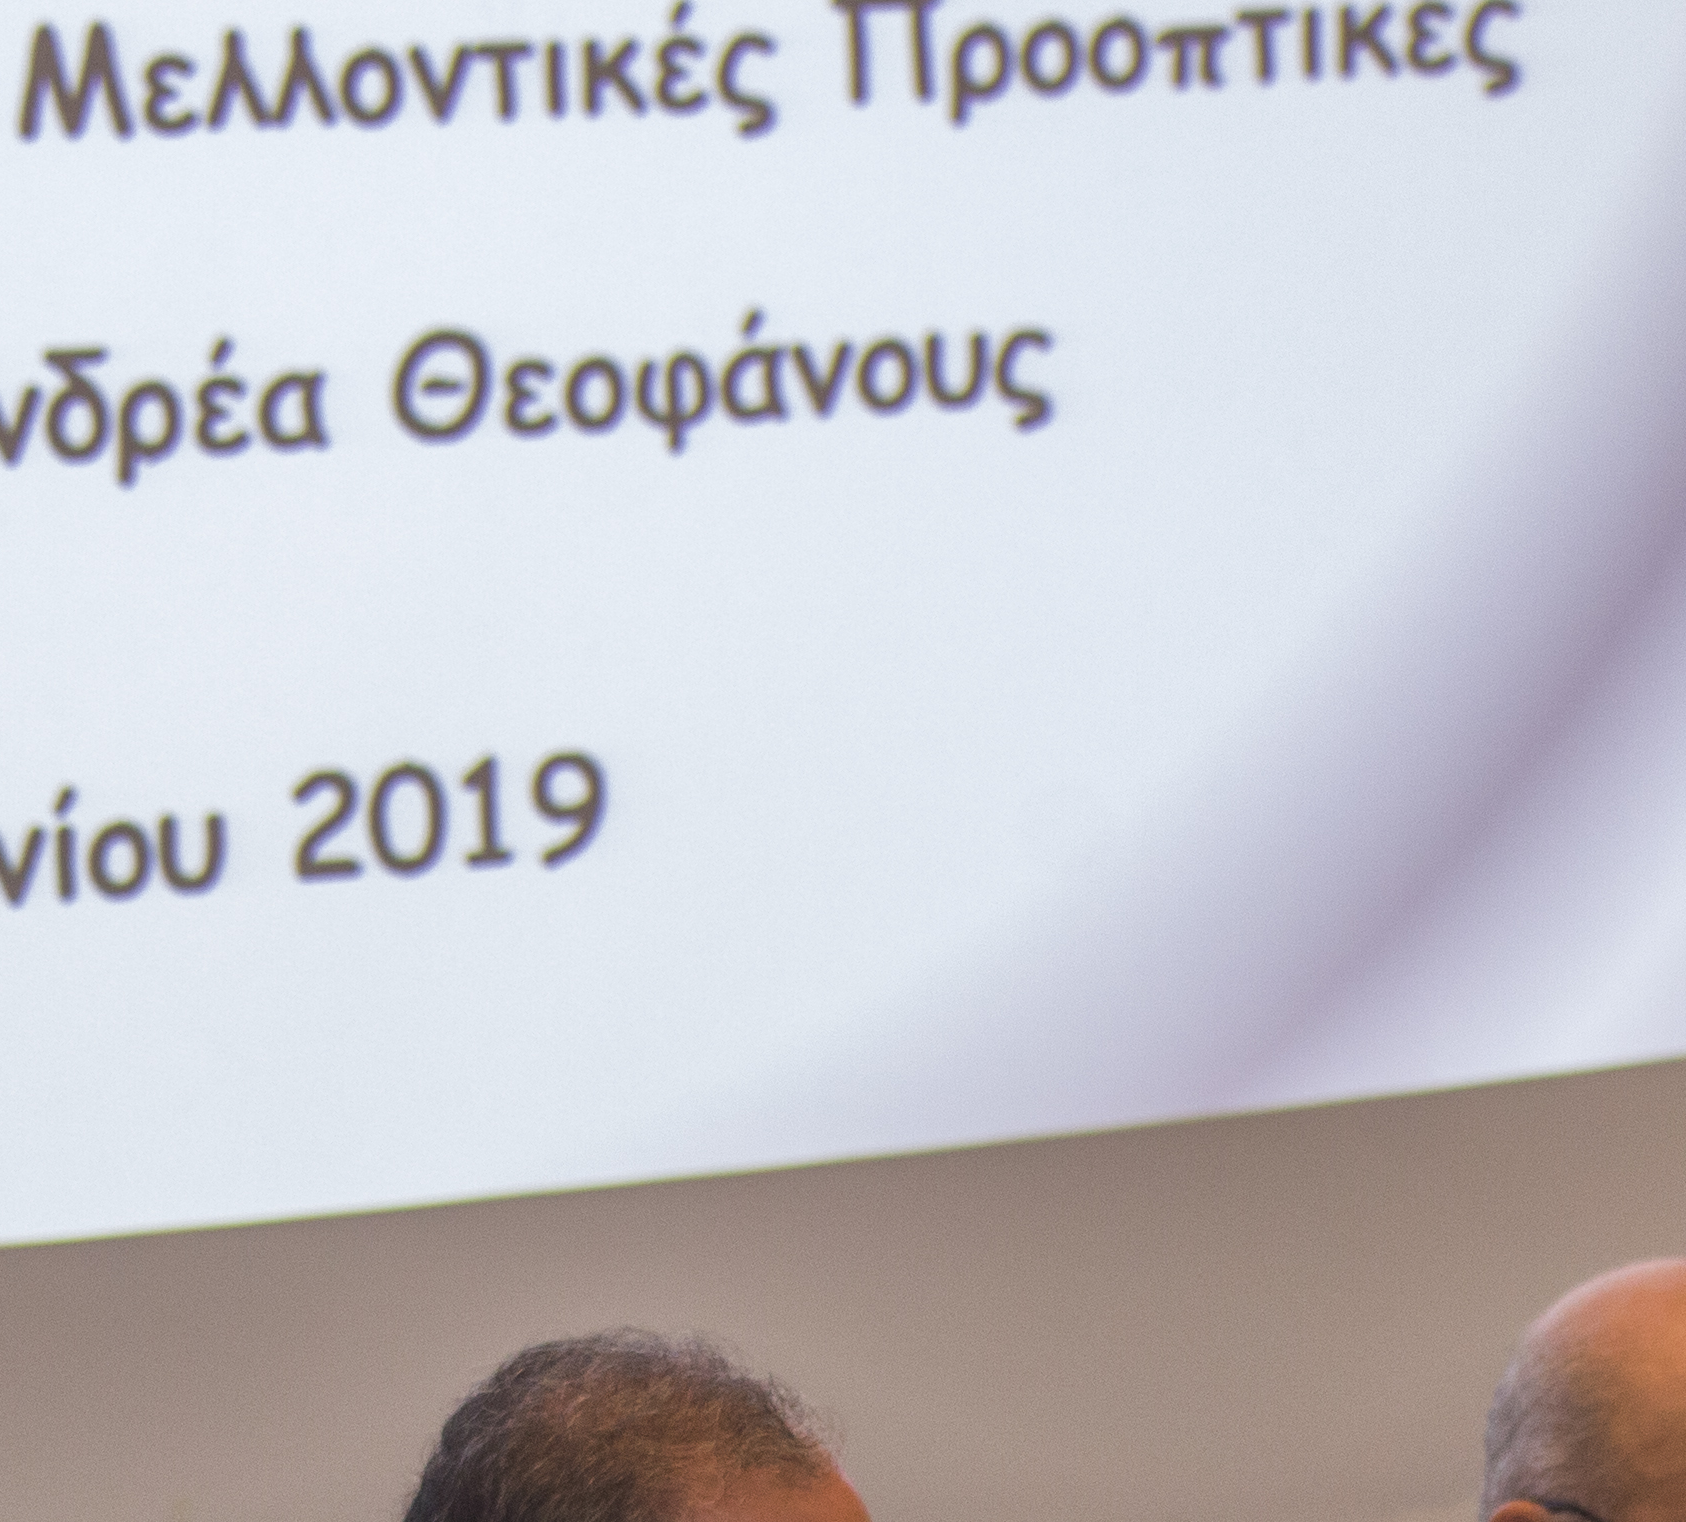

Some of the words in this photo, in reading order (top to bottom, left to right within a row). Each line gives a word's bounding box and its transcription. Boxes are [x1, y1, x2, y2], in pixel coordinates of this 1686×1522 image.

[16, 2, 779, 144] Μελλοντικές
[389, 308, 1056, 456] Θεοφάνους
[290, 749, 610, 884] 2019
